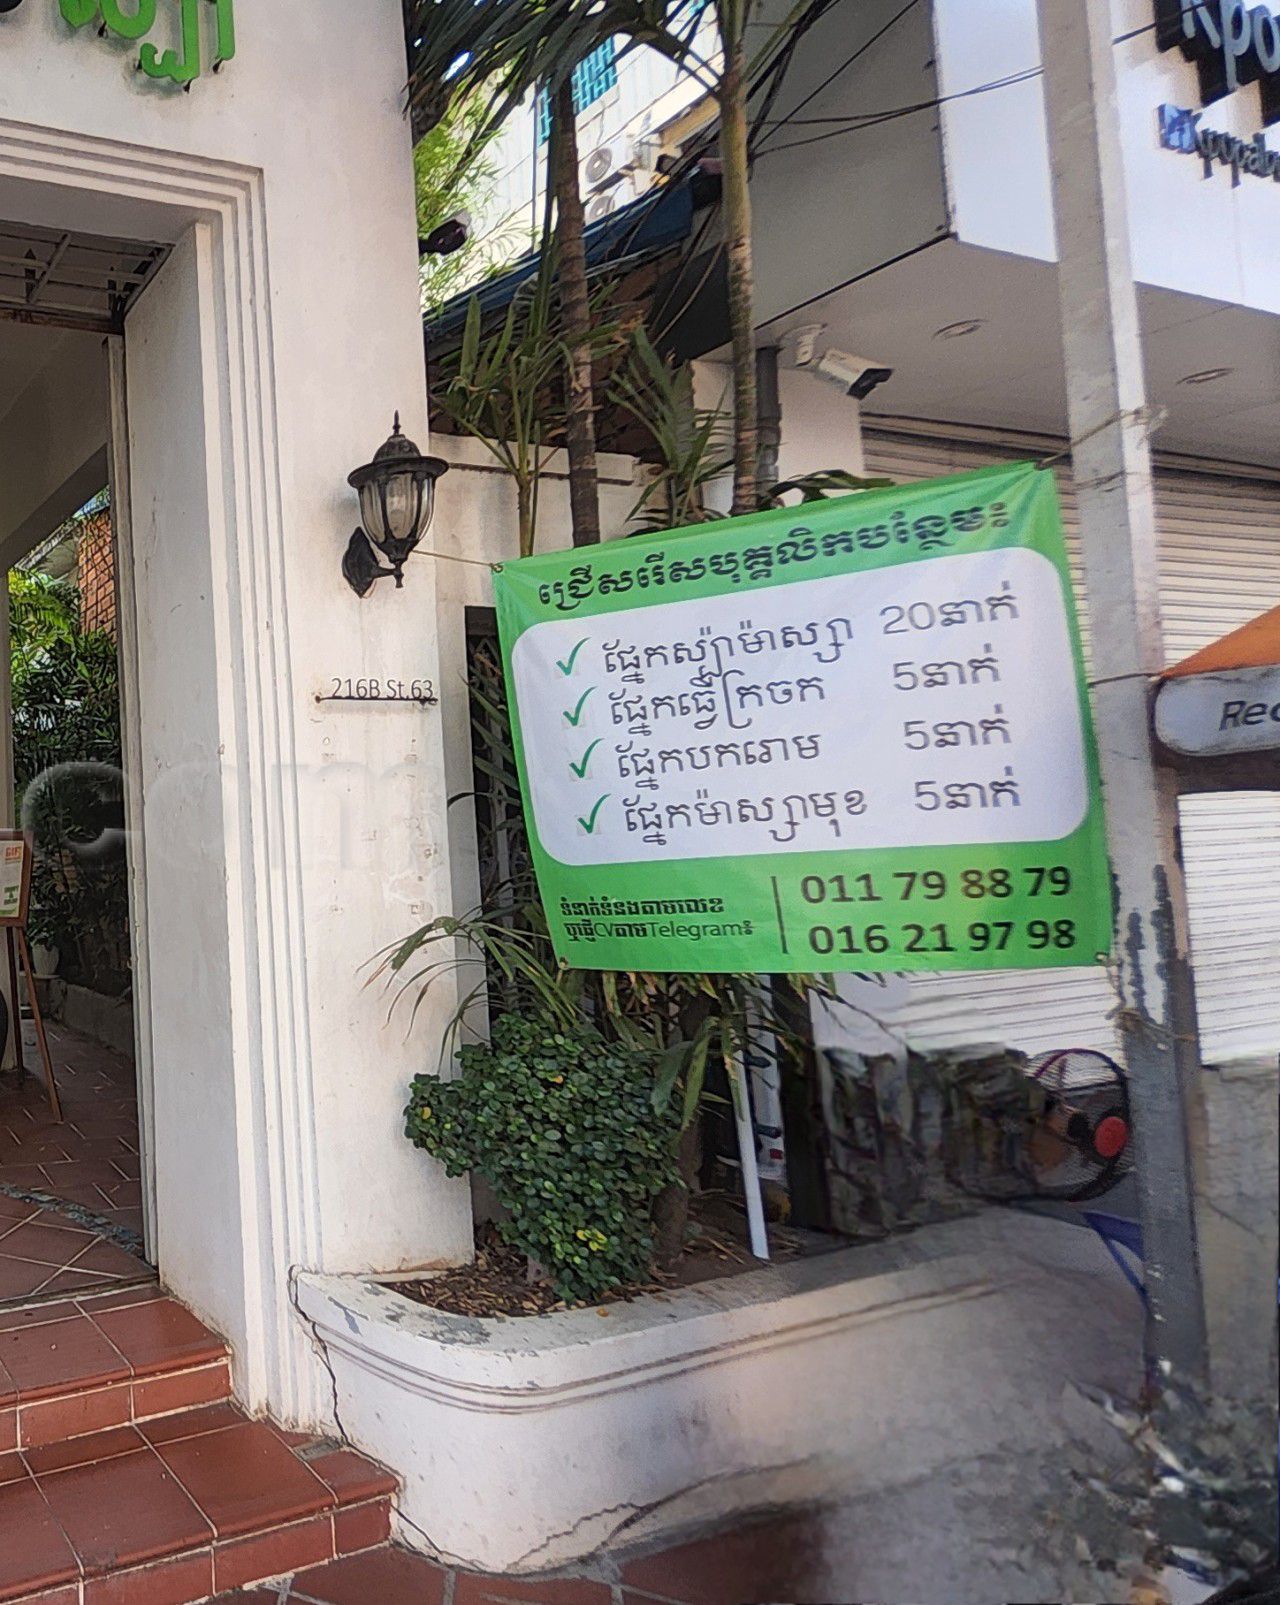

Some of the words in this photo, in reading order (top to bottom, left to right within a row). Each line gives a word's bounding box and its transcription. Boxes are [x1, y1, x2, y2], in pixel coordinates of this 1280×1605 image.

[879, 580, 1019, 635] 20នាក់
[331, 677, 381, 700] 216B
[893, 642, 1001, 691] 5នាក់
[904, 703, 1012, 750] 5នាក់
[915, 766, 1021, 811] 5នាក់
[801, 873, 883, 904] 011
[892, 870, 946, 900] 79
[960, 868, 1013, 899] 88
[1023, 866, 1071, 897] 79
[809, 925, 890, 954] 016
[901, 923, 958, 952] 21
[968, 921, 1015, 951] 97
[1027, 919, 1076, 950] 98
